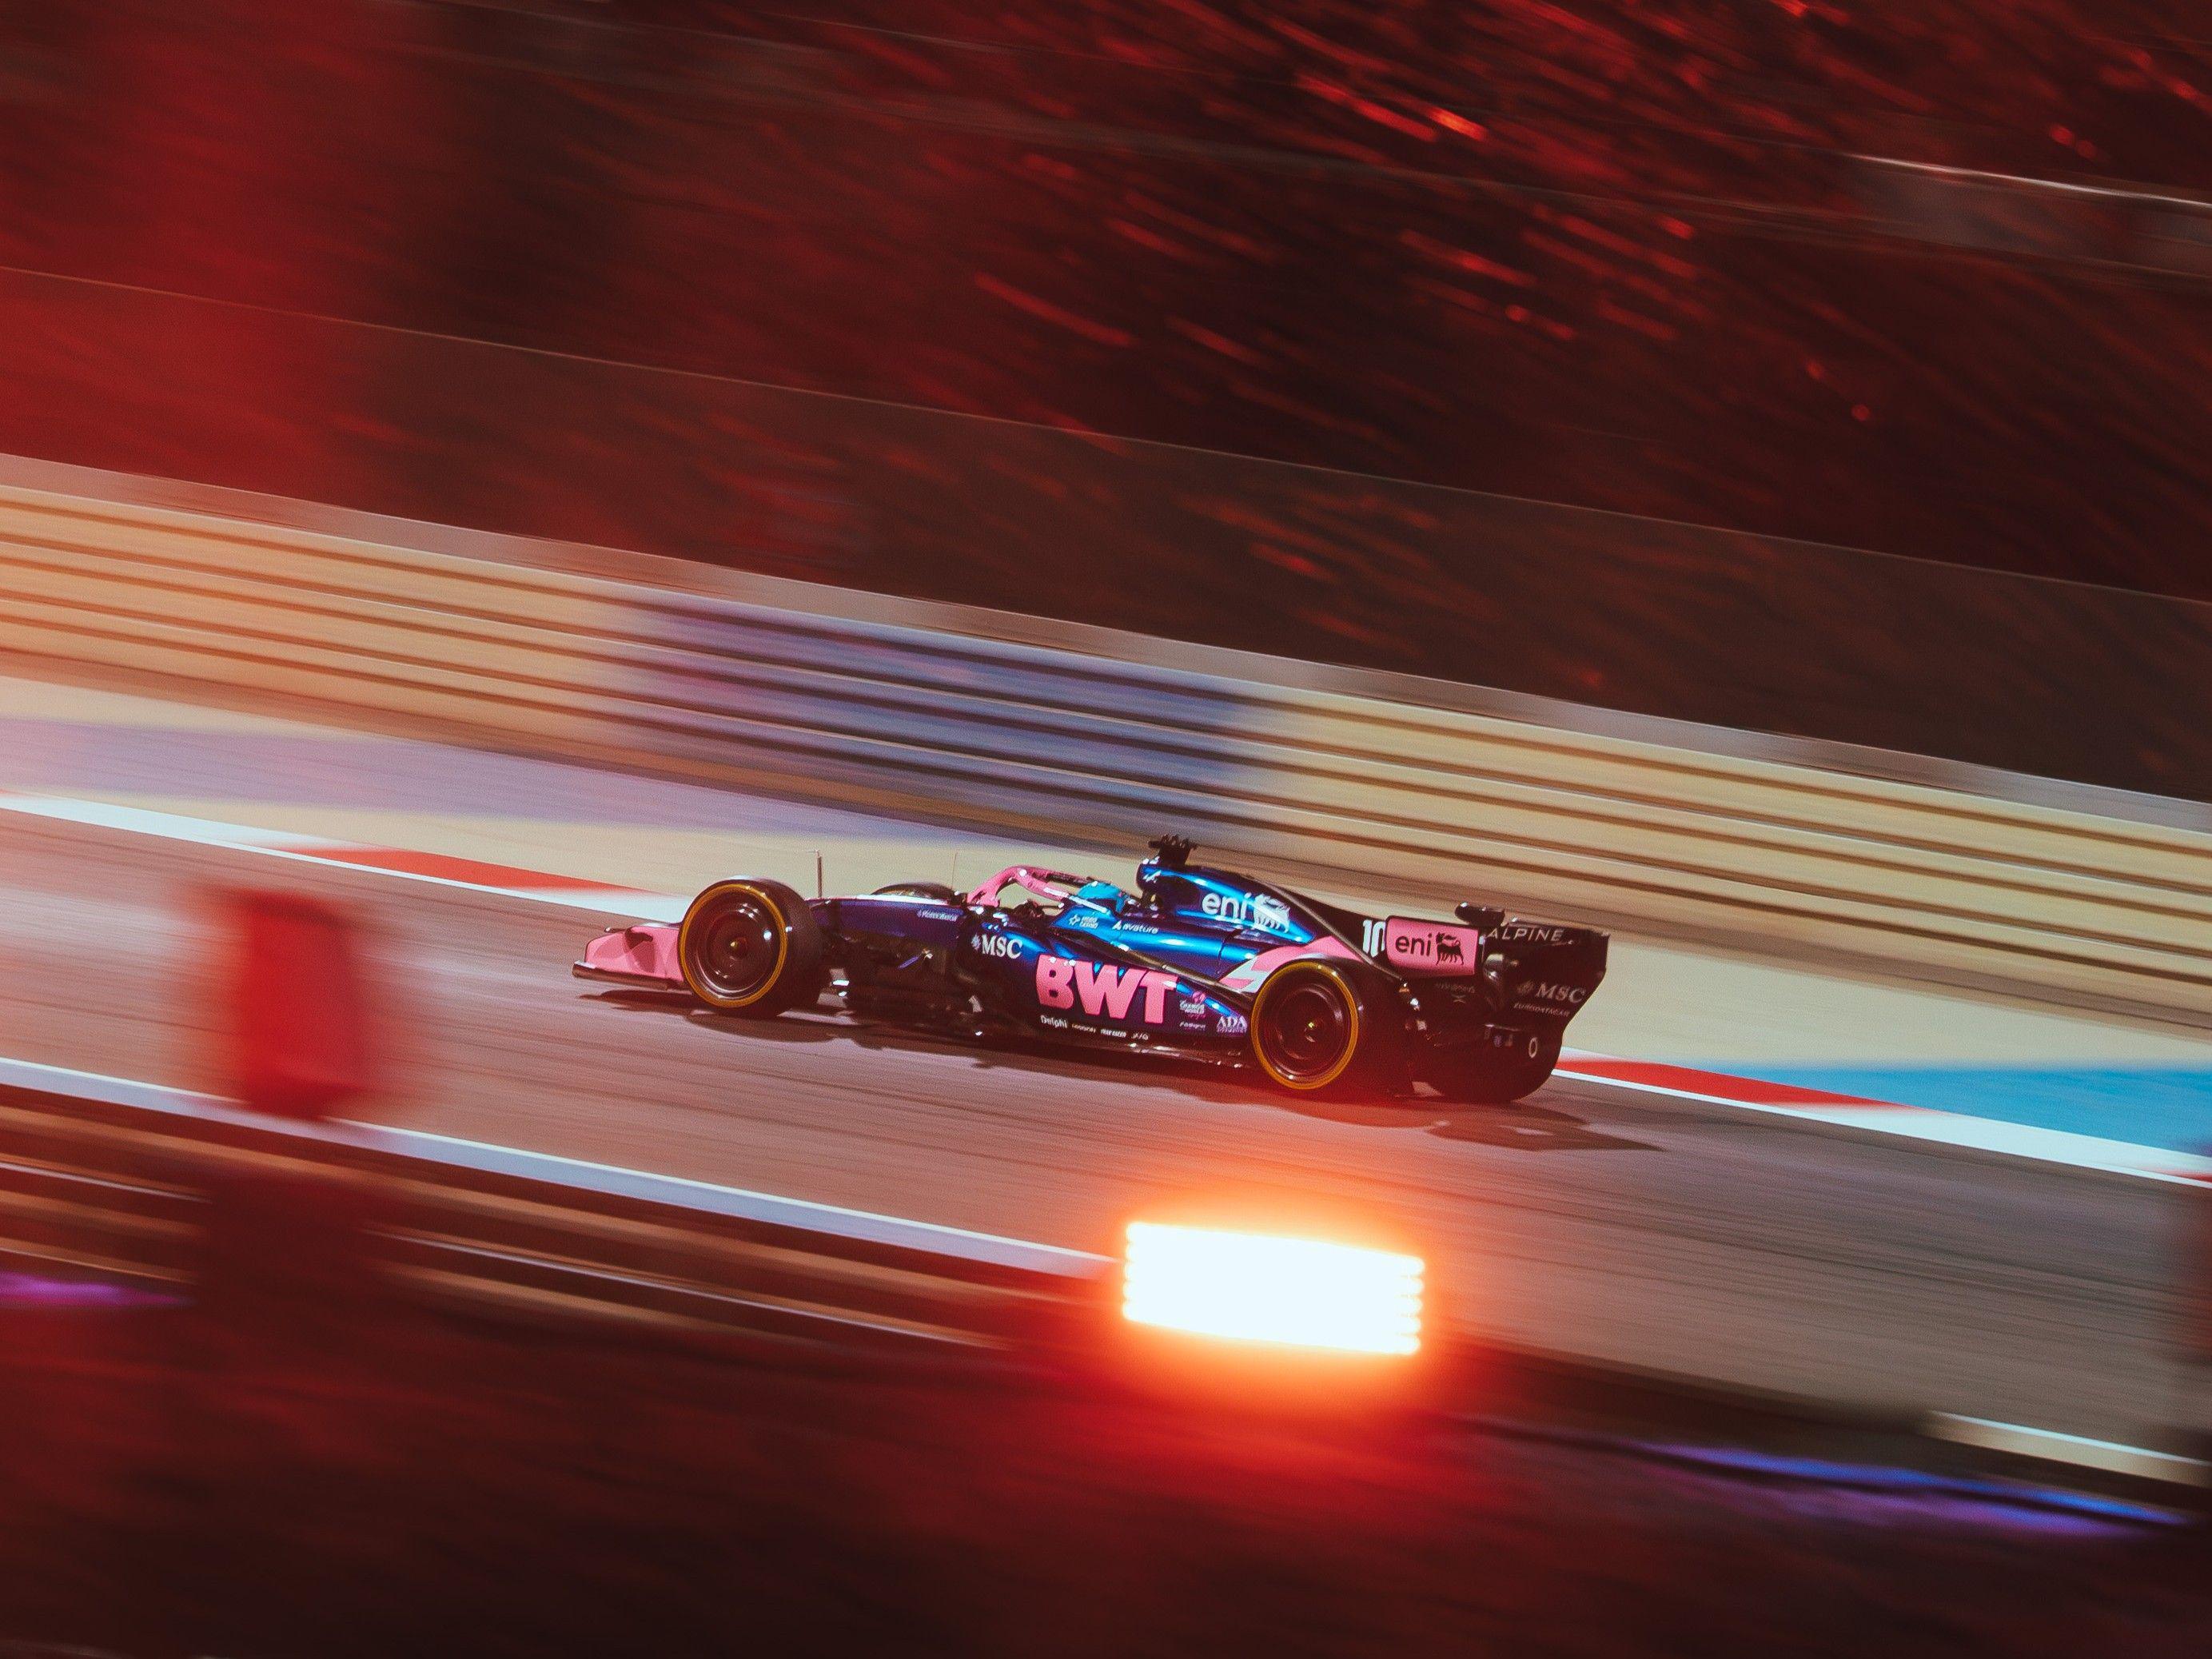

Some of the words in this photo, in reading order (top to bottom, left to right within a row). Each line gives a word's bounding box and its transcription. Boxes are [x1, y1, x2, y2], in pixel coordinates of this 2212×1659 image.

[1202, 891, 1252, 921] eni
[982, 934, 1023, 959] MSC
[1395, 932, 1433, 957] eni
[1487, 926, 1565, 942] ALPINE
[1036, 954, 1178, 1024] BWT
[1535, 982, 1587, 1004] MSC
